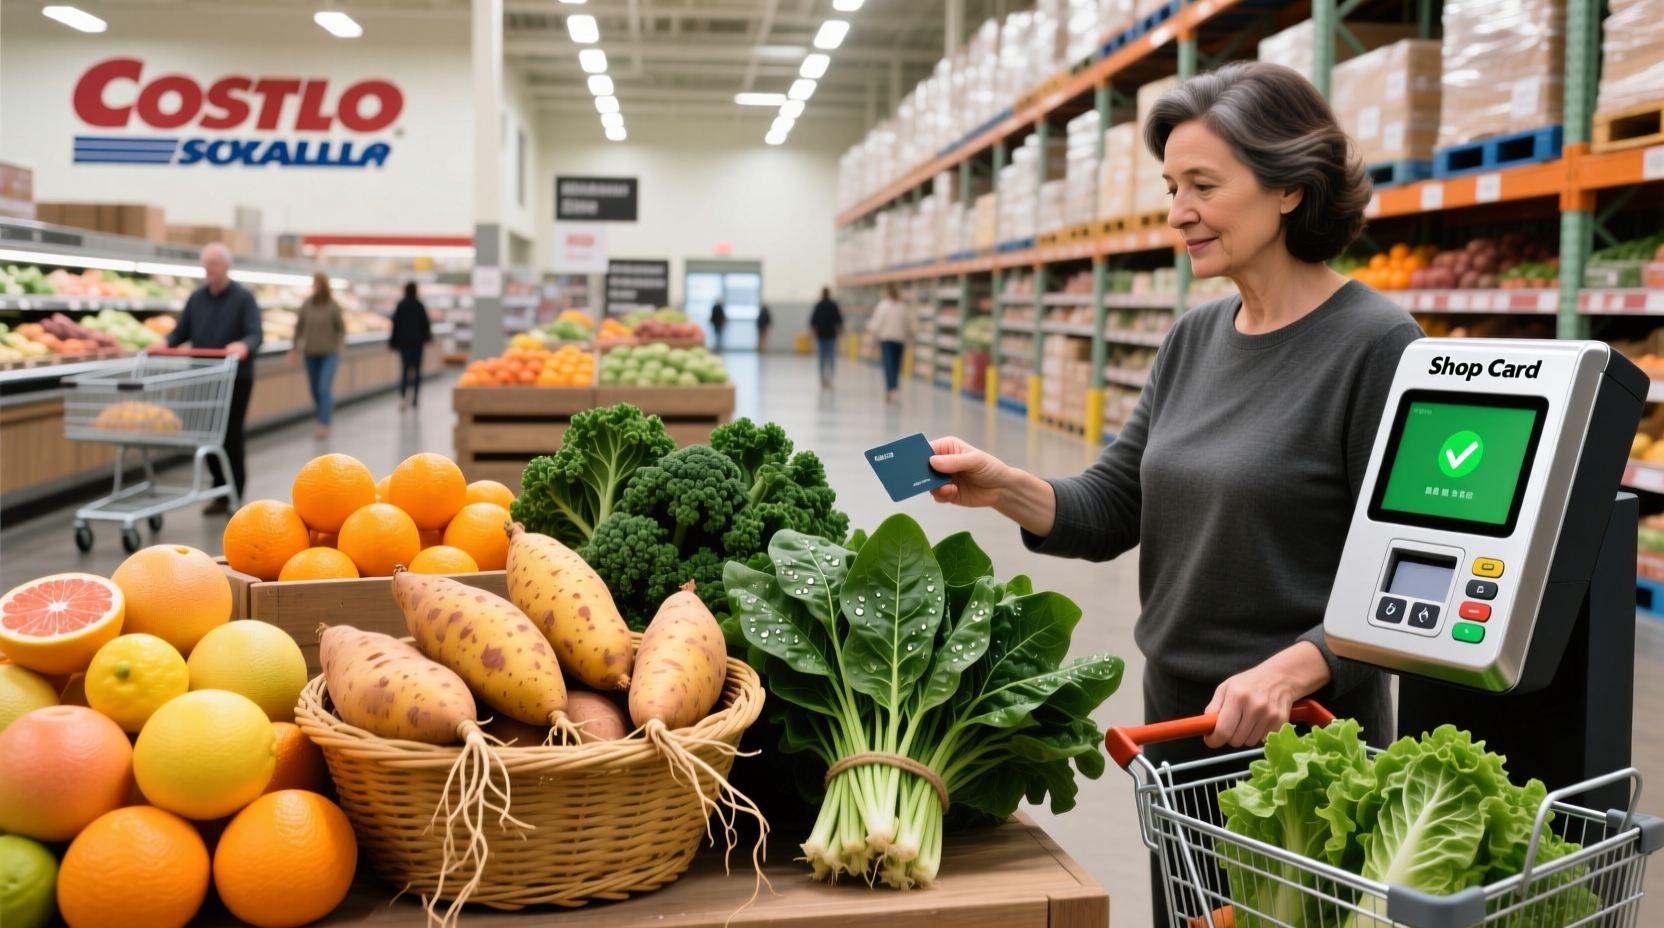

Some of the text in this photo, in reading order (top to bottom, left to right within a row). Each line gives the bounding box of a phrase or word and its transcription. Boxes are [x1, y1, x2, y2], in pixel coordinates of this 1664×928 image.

[73, 58, 403, 132] COSTLO
[1428, 355, 1543, 382] Shop Card
